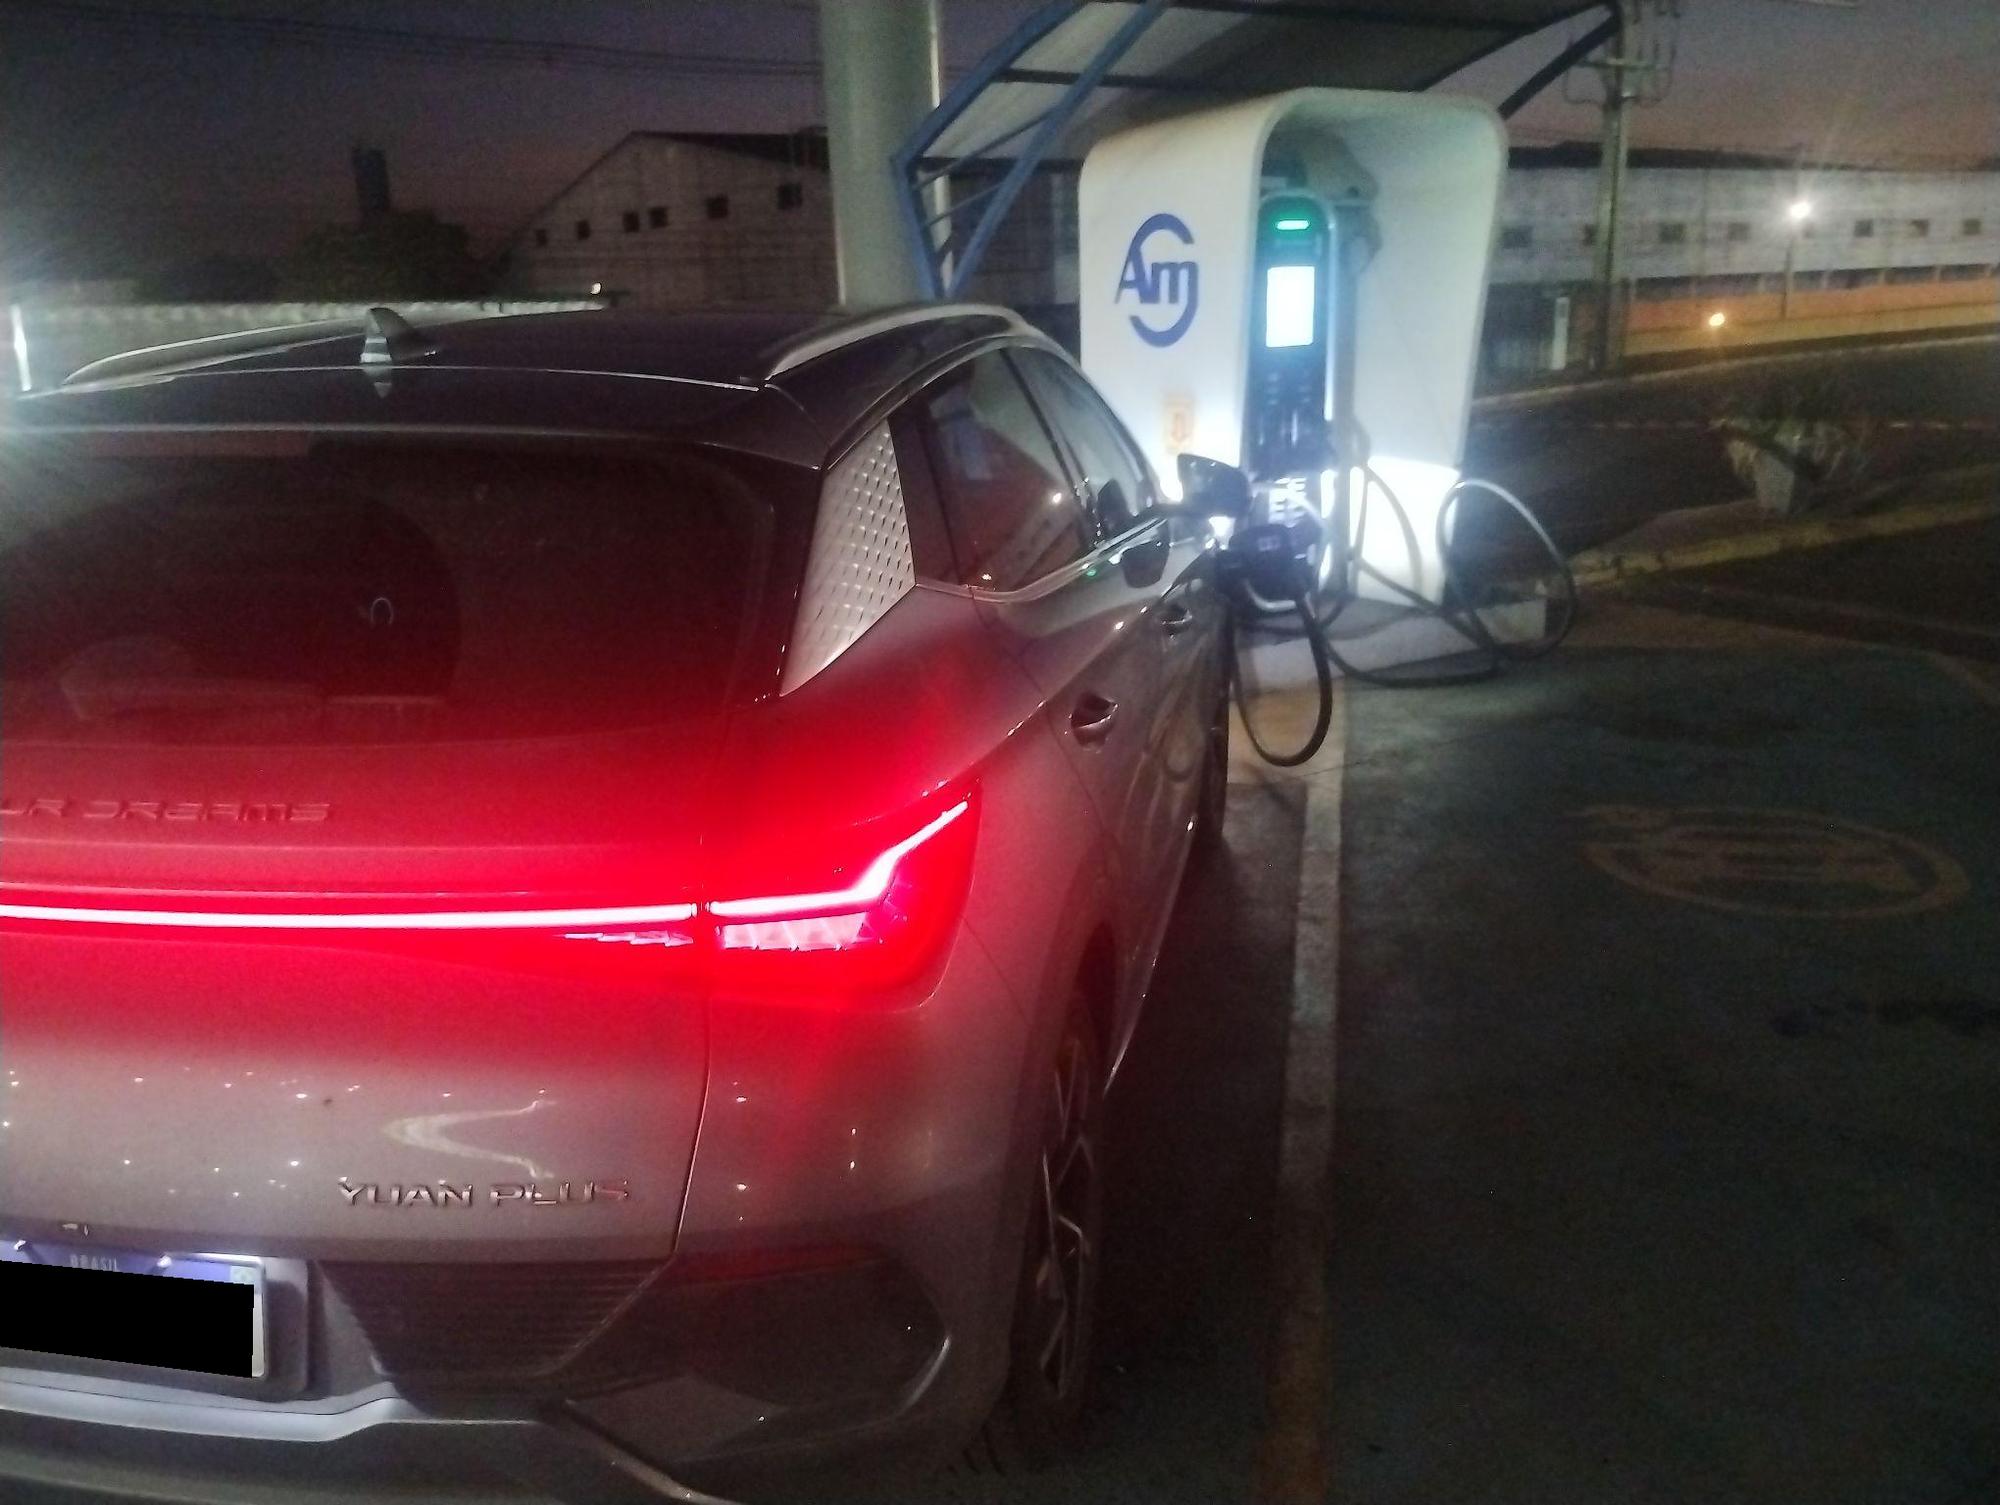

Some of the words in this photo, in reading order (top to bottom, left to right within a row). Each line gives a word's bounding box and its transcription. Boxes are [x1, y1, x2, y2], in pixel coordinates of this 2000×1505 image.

[83, 801, 330, 822] DREAMS
[338, 1177, 473, 1207] YUAN
[490, 1181, 629, 1208] PLUS
